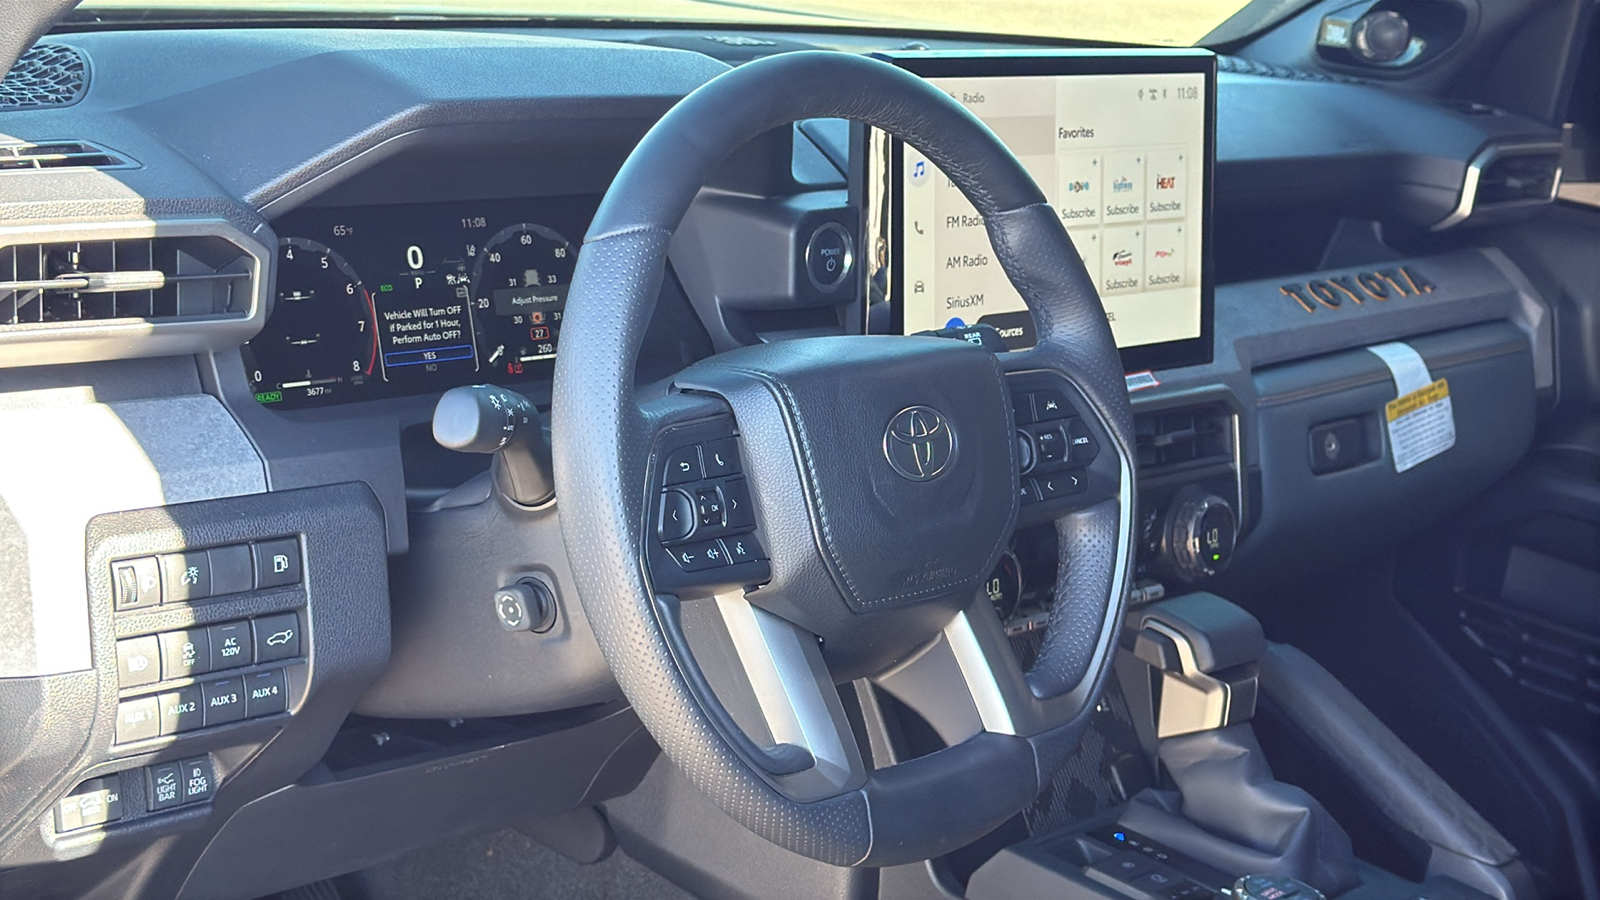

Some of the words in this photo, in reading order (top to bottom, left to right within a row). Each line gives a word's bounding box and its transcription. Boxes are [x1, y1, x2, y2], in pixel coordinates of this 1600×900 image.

[963, 92, 985, 103] Radio
[1178, 87, 1198, 99] 11:08
[1058, 127, 1095, 139] Favorites
[1106, 204, 1139, 216] Subscribe
[1149, 201, 1181, 213] Subscribe
[1062, 208, 1095, 219] Subscribe
[461, 217, 487, 228] 11:08
[946, 216, 959, 228] FM
[520, 234, 532, 245] 60
[286, 249, 293, 260] 4
[554, 248, 566, 258] 80
[820, 247, 840, 256] POWER
[321, 257, 329, 269] 5
[407, 245, 424, 270] 0
[489, 252, 501, 263] 40
[946, 256, 961, 269] AM
[962, 254, 988, 268] Radio
[414, 277, 422, 289] P
[508, 278, 517, 287] 31
[547, 274, 557, 284] 33
[1106, 278, 1138, 290] Subscribe
[1148, 273, 1180, 286] Subscribe
[346, 283, 354, 295] 6
[381, 284, 393, 292] ECO
[1279, 265, 1438, 314] TOYOTA
[477, 298, 489, 309] 20
[511, 296, 532, 306] Adjust
[532, 295, 558, 303] Pressure
[946, 294, 984, 309] SiriusXM
[383, 310, 412, 321] Vehicle
[412, 308, 428, 318] Will
[428, 307, 446, 317] Turn
[446, 305, 462, 315] OFF
[357, 320, 365, 332] 7
[396, 322, 422, 332] Parked
[422, 320, 433, 329] for
[440, 319, 461, 329] Hour,
[513, 316, 523, 325] 30
[392, 334, 422, 345] Perform
[423, 333, 441, 342] Auto
[442, 330, 461, 340] OFF?
[534, 329, 544, 338] 27
[963, 331, 981, 339] REAR
[537, 343, 552, 354] 260
[423, 351, 437, 360] YES
[353, 360, 360, 372] 8
[425, 364, 437, 372] NO
[254, 370, 262, 382] 0
[306, 387, 324, 396] 3677
[256, 393, 280, 402] READY
[1072, 436, 1089, 446] CANCEL
[1206, 527, 1219, 545] LO
[986, 578, 1000, 595] LO
[224, 637, 237, 647] AC
[221, 646, 241, 657] 120V
[183, 659, 195, 667] OFF
[252, 688, 271, 699] AUX
[271, 685, 279, 696] 4
[210, 695, 230, 707] AUX
[230, 693, 238, 704] 3
[168, 703, 188, 716] AUX
[189, 702, 196, 712] 2
[124, 711, 146, 724] AUX
[156, 782, 177, 794] LIGHT
[189, 777, 206, 788] FOG
[188, 784, 208, 795] LIGHT
[106, 793, 119, 803] ON
[158, 791, 176, 802] BAR
